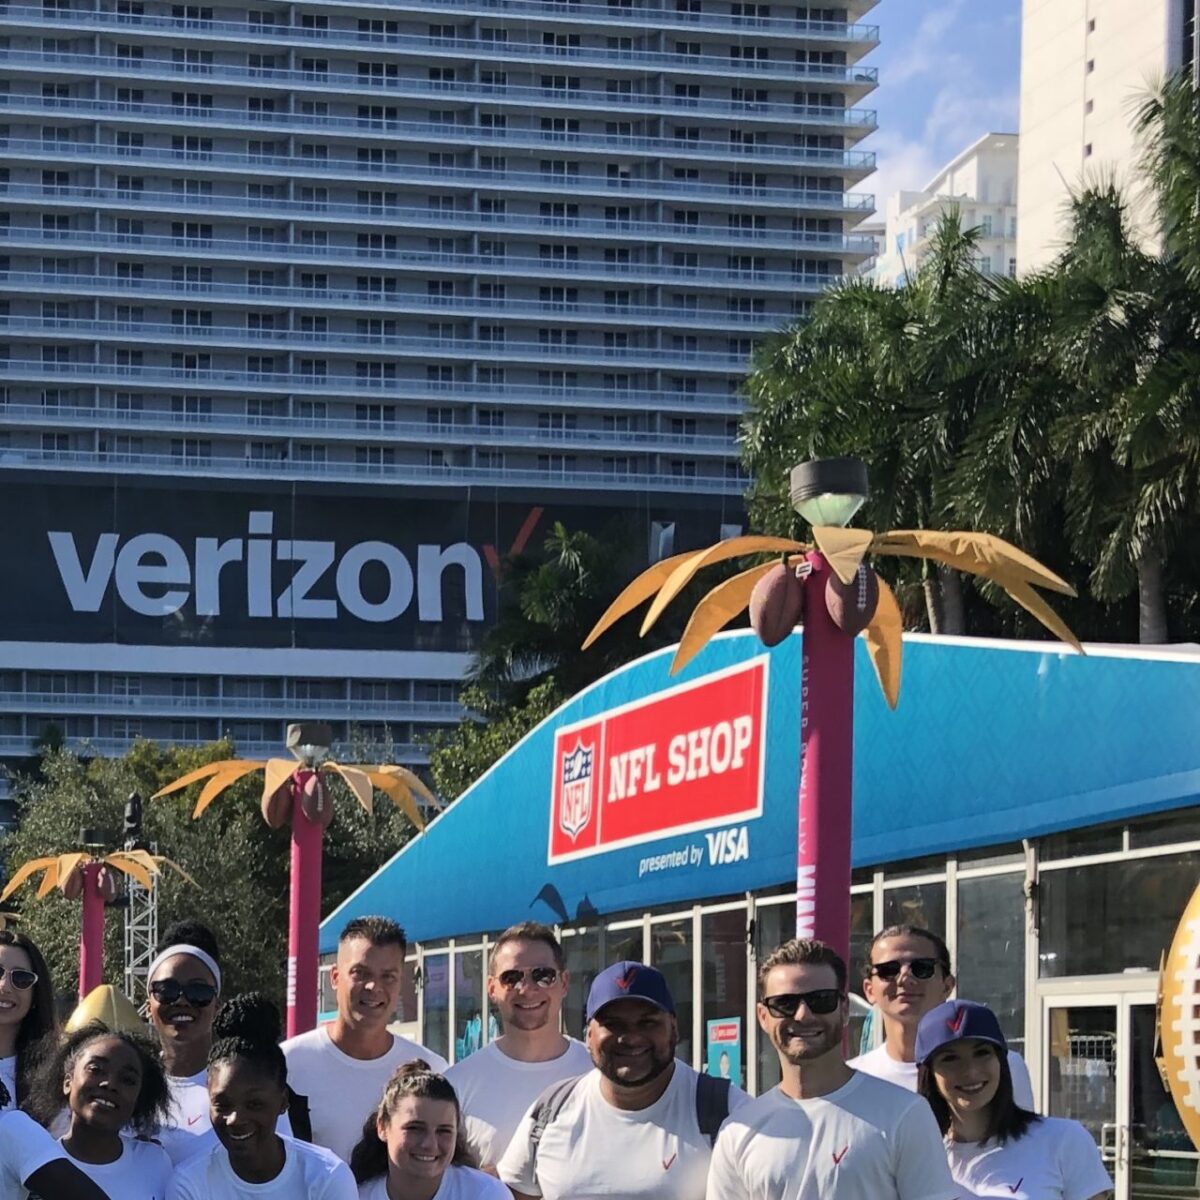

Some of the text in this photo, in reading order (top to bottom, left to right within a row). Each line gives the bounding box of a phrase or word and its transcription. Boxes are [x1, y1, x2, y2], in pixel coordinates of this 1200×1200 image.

[47, 511, 485, 622] verizon
[608, 715, 753, 803] NFL SHOP
[638, 826, 749, 878] presented by VISA
[796, 864, 817, 939] MIAM
